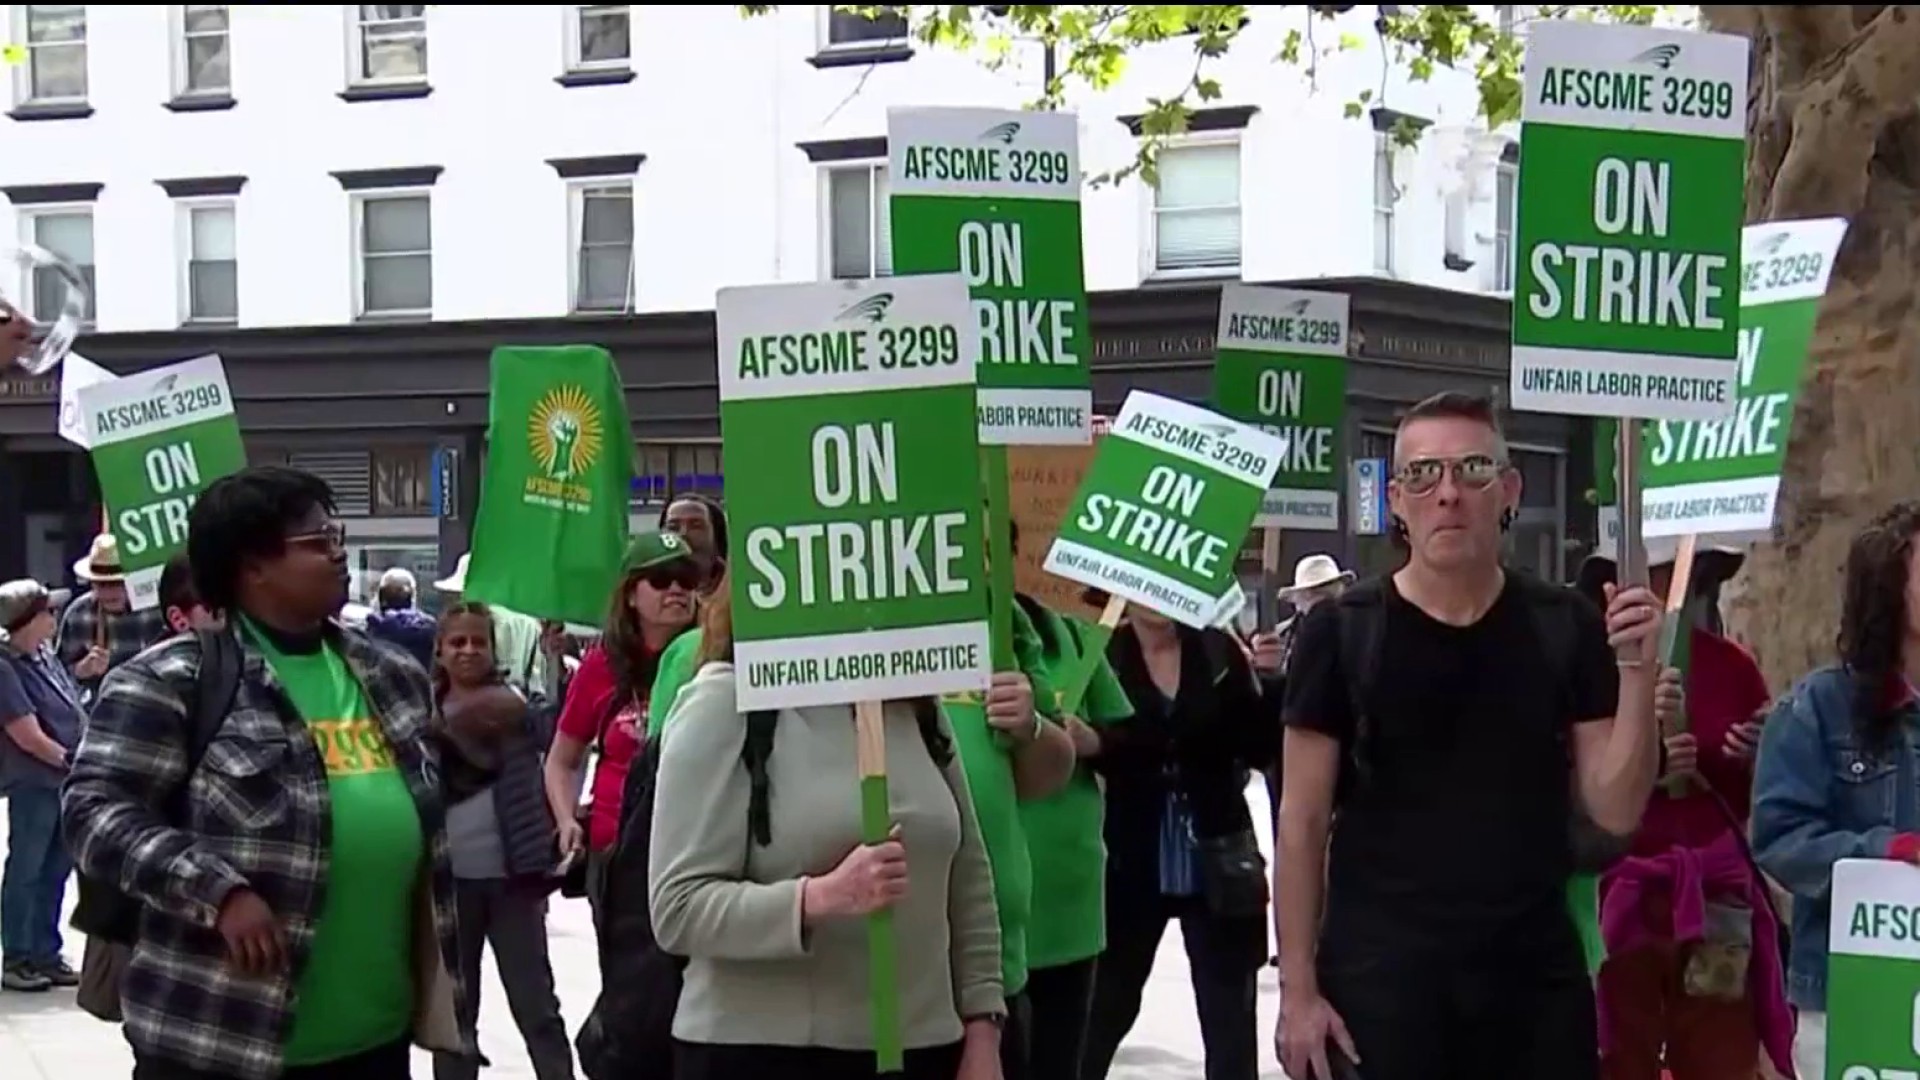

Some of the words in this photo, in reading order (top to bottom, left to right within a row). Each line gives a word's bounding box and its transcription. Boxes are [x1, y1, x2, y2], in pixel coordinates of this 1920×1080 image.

[1540, 66, 1653, 112] AFSCME
[1663, 76, 1733, 120] 3299
[904, 145, 1001, 182] AFSCME
[1009, 151, 1069, 184] 3299
[1593, 157, 1670, 237] ON
[959, 221, 1024, 288] ON
[1765, 252, 1822, 289] 3299
[1528, 241, 1727, 330] STRIKE
[738, 329, 868, 379] AFSCME
[879, 324, 959, 370] 3299
[1228, 313, 1293, 342] AFSCME
[1298, 319, 1341, 345] 3299
[96, 395, 171, 435] AFSCME
[172, 383, 222, 416] 3299
[1258, 369, 1302, 419] ON
[1523, 367, 1582, 394] UNFAIR
[1586, 370, 1641, 398] LABOR
[1645, 374, 1726, 403] PRACTICE
[1018, 406, 1084, 428] PRACTICE
[146, 441, 200, 494] ON
[811, 421, 898, 509] ON
[1126, 412, 1210, 455] AFSCME
[1211, 440, 1267, 477] 3299
[1141, 465, 1206, 518] ON
[120, 494, 195, 554] STR
[1077, 493, 1228, 578] STRIKE
[745, 512, 969, 609] STRIKE
[1055, 551, 1101, 575] UNFAIR
[1102, 566, 1143, 590] LABOR
[1143, 581, 1204, 616] PRACTICE
[748, 657, 819, 688] UNFAIR
[824, 651, 886, 682] LABOR
[890, 643, 978, 676] PRACTICE
